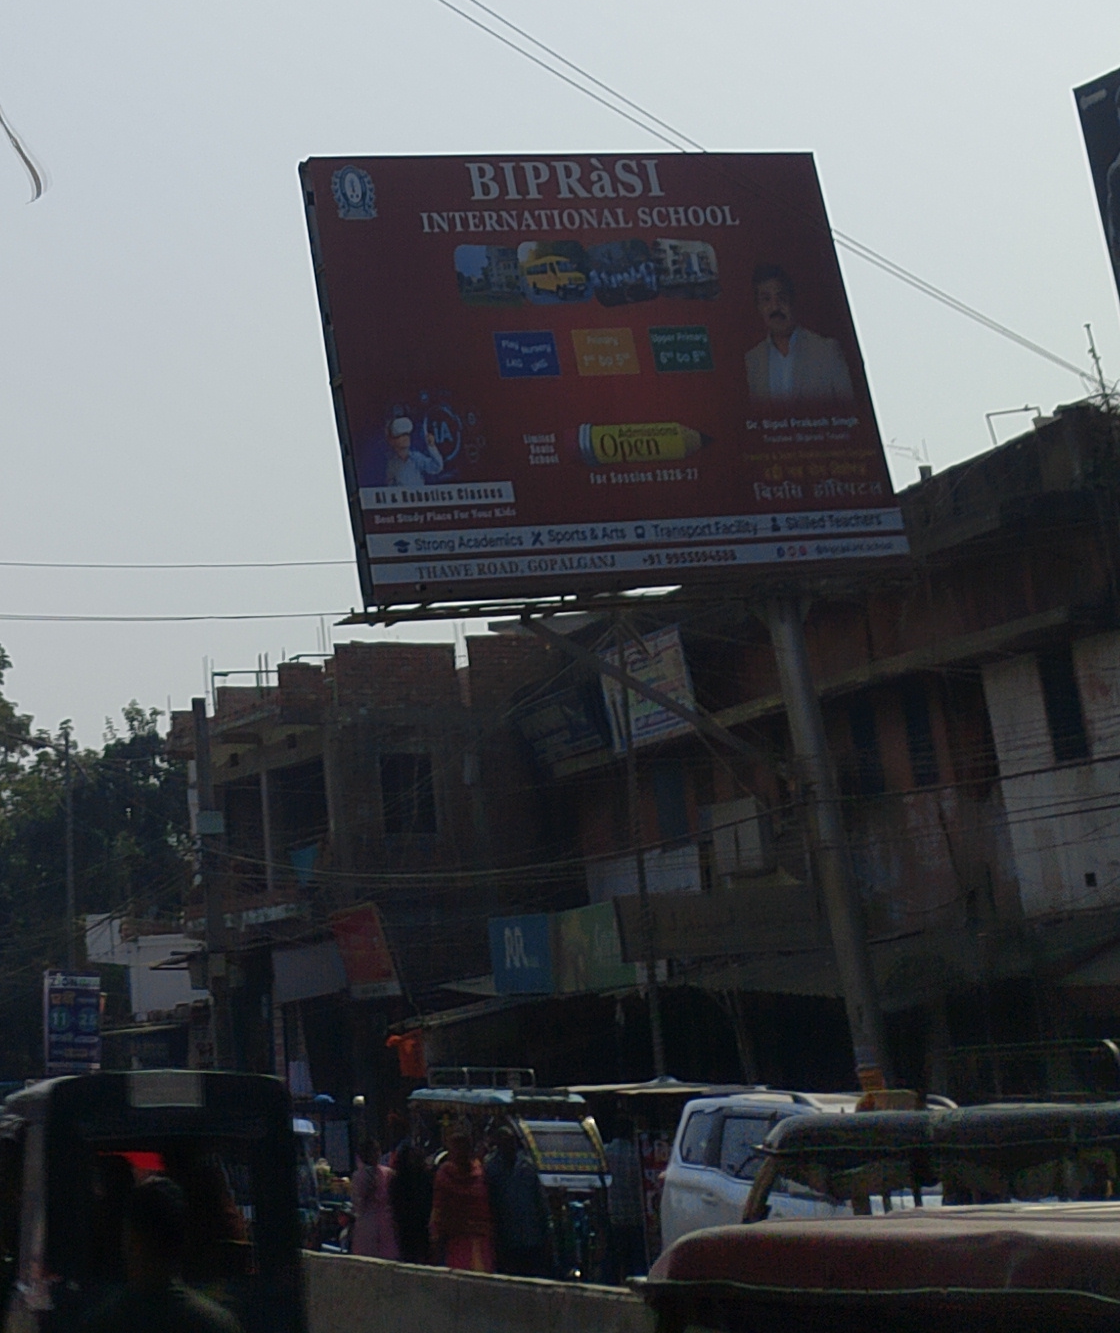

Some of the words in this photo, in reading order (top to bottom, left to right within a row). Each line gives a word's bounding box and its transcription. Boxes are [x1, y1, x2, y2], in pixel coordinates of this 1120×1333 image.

[421, 207, 632, 233] INTERNATIONAL
[638, 205, 740, 228] SCHOOL
[586, 336, 619, 346] Primary
[652, 334, 675, 344] Upper
[677, 332, 708, 343] Primary
[521, 343, 551, 354] Nursery
[598, 355, 614, 367] to
[676, 352, 690, 363] to
[618, 427, 678, 438] Admissions
[523, 434, 556, 444] Limited
[600, 433, 660, 463] Open
[528, 454, 560, 465] School
[610, 471, 654, 484] Session
[375, 492, 386, 504] AI
[402, 489, 454, 504] Robotics
[457, 487, 503, 501] Classes
[373, 514, 395, 525] Best
[396, 513, 424, 525] Study
[426, 511, 452, 522] Place
[453, 510, 469, 520] For
[471, 508, 493, 519] Your
[494, 507, 516, 518] Kids
[414, 537, 455, 552] Strong
[458, 533, 524, 550] Academics
[548, 528, 588, 543] Sports
[589, 528, 600, 541] &
[601, 526, 626, 540] Arts
[651, 521, 712, 538] Transport
[714, 519, 757, 536] Facility
[785, 515, 825, 530] Skilled
[829, 512, 883, 528] Teachers
[417, 564, 474, 580] THAWE
[527, 554, 617, 574] GOPALGANJ
[642, 554, 662, 567] +91
